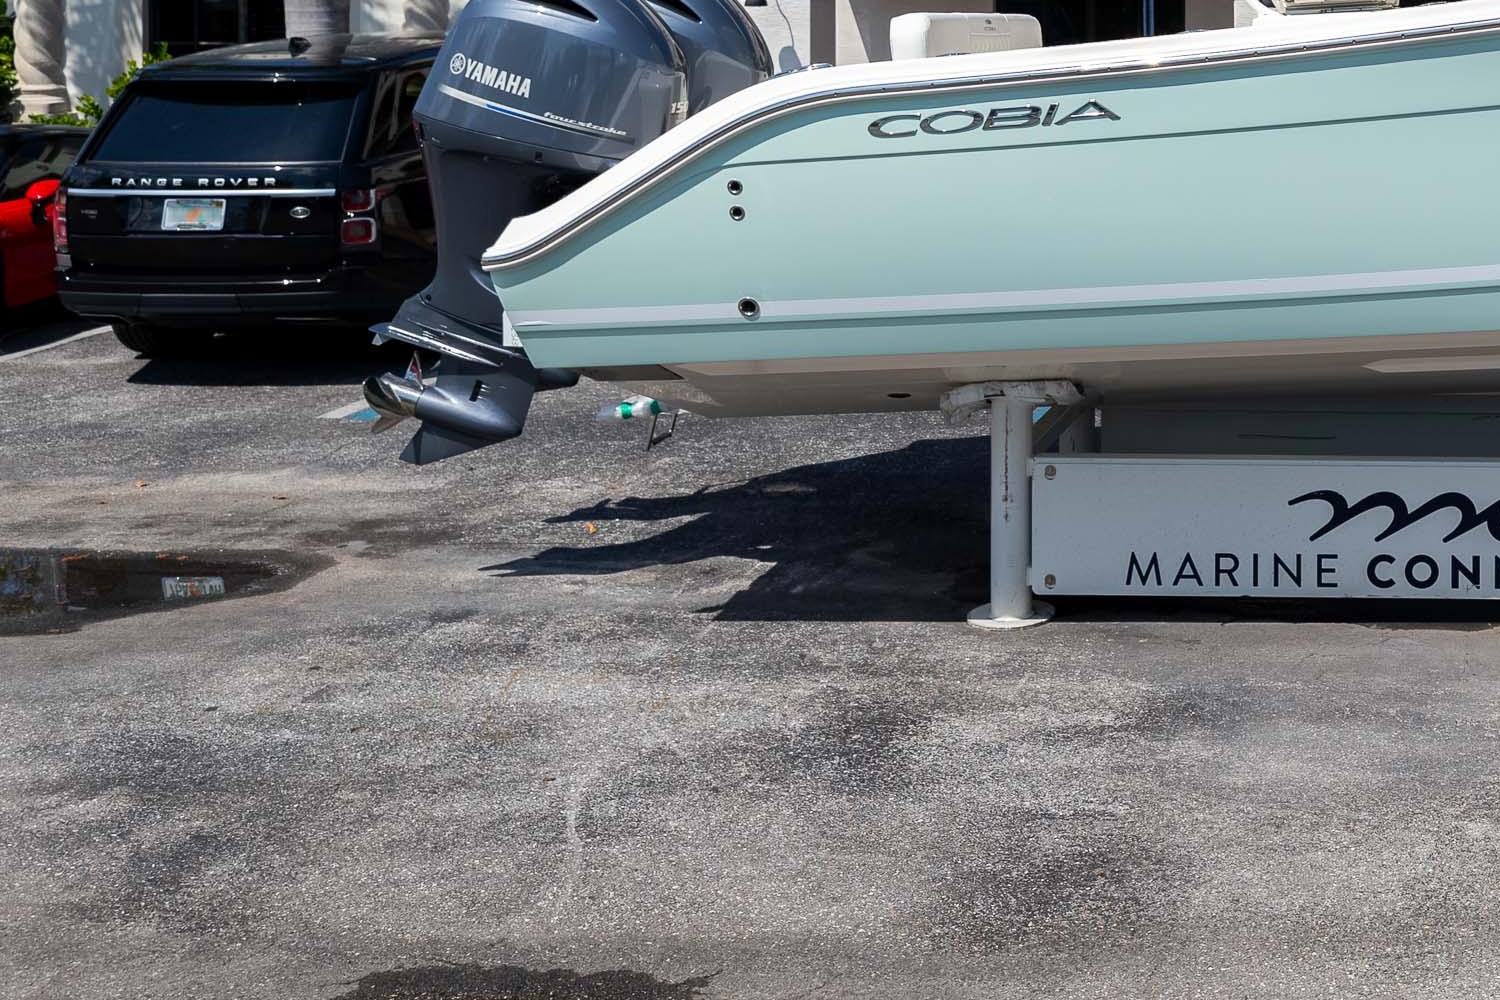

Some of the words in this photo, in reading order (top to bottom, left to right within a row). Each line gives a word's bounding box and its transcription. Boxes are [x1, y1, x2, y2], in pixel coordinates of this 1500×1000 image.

[464, 58, 532, 99] YAMAHA
[867, 98, 1121, 139] COBIA
[111, 177, 183, 187] RANGE
[198, 177, 277, 187] ROVER
[1125, 551, 1339, 588] MARINE
